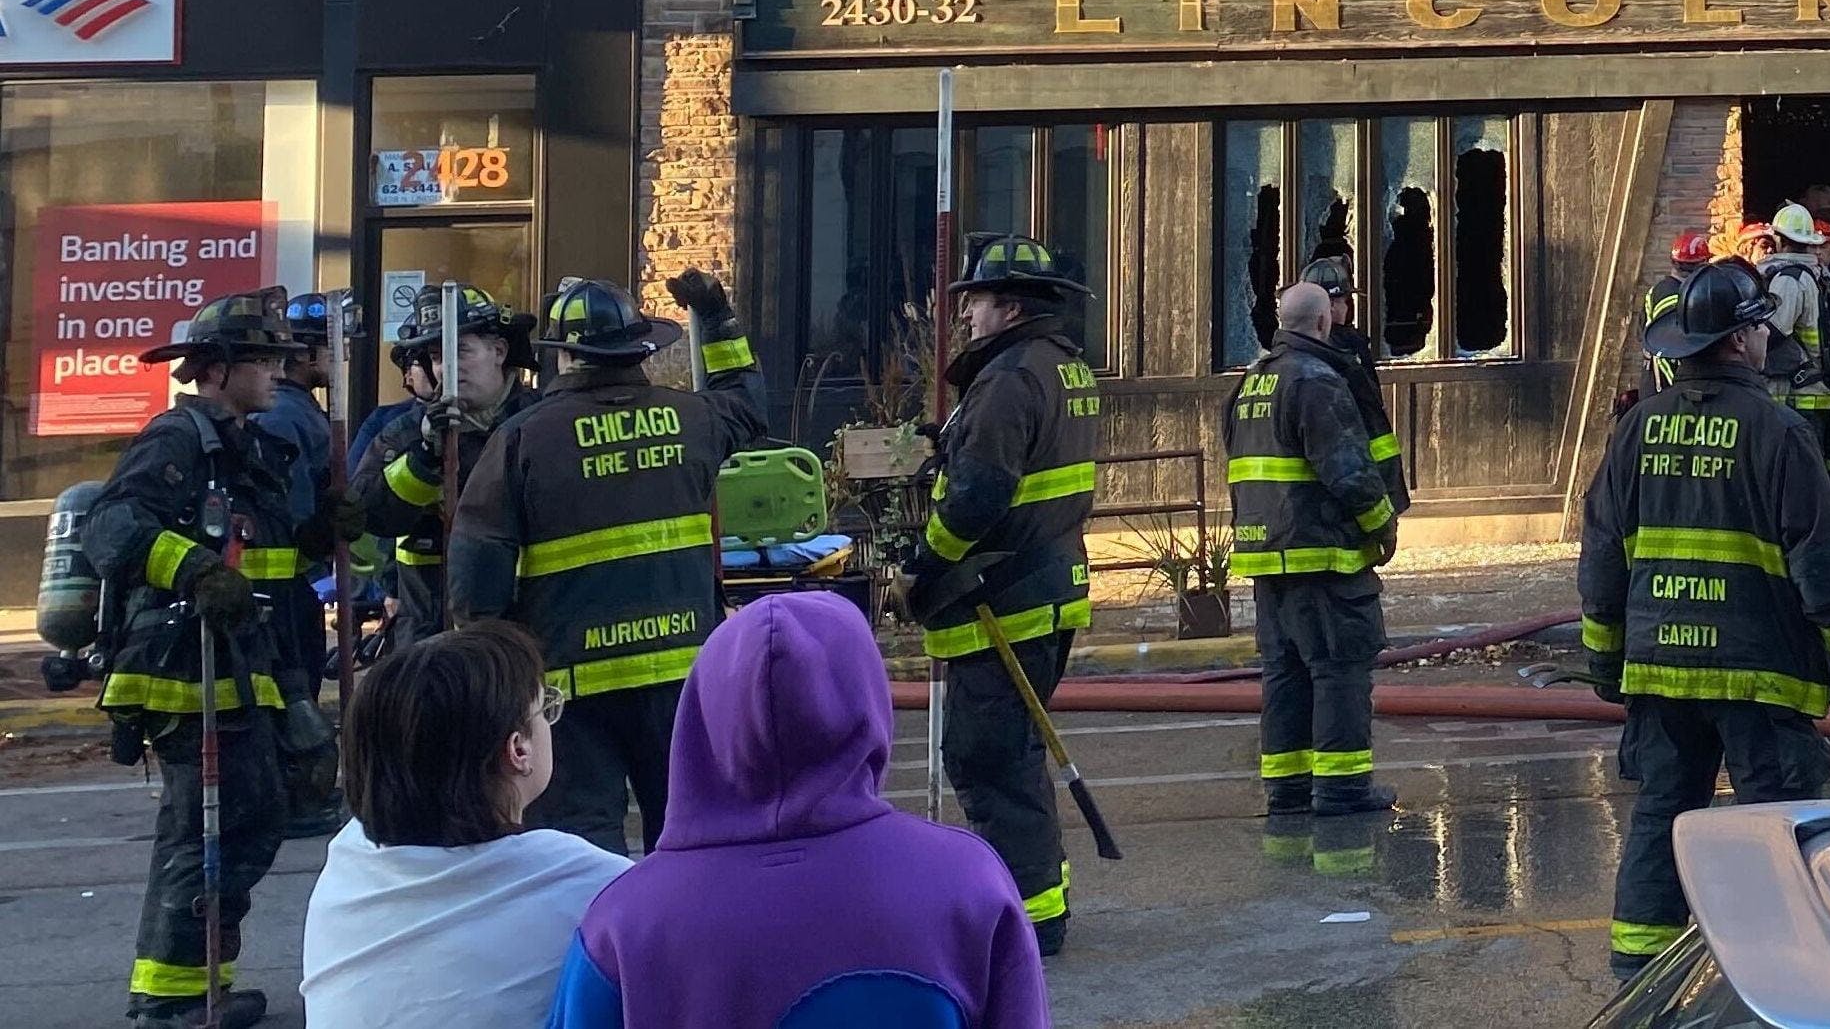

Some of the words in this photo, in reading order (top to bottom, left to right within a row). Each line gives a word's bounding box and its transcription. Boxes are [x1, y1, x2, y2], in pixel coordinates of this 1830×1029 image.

[61, 233, 189, 267] Banking
[198, 230, 258, 260] and
[59, 273, 205, 307] investing
[57, 313, 86, 340] in
[94, 316, 155, 339] one
[54, 348, 139, 385] place
[575, 407, 682, 447] CHICAGO
[1644, 415, 1739, 449] CHICAGO
[582, 451, 629, 479] FIRE
[637, 444, 685, 470] DEPT
[1640, 454, 1685, 476] FIRE
[1692, 455, 1736, 480] DEPT
[1652, 575, 1726, 601] CAPTAIN
[585, 611, 697, 650] MURKOWSKI
